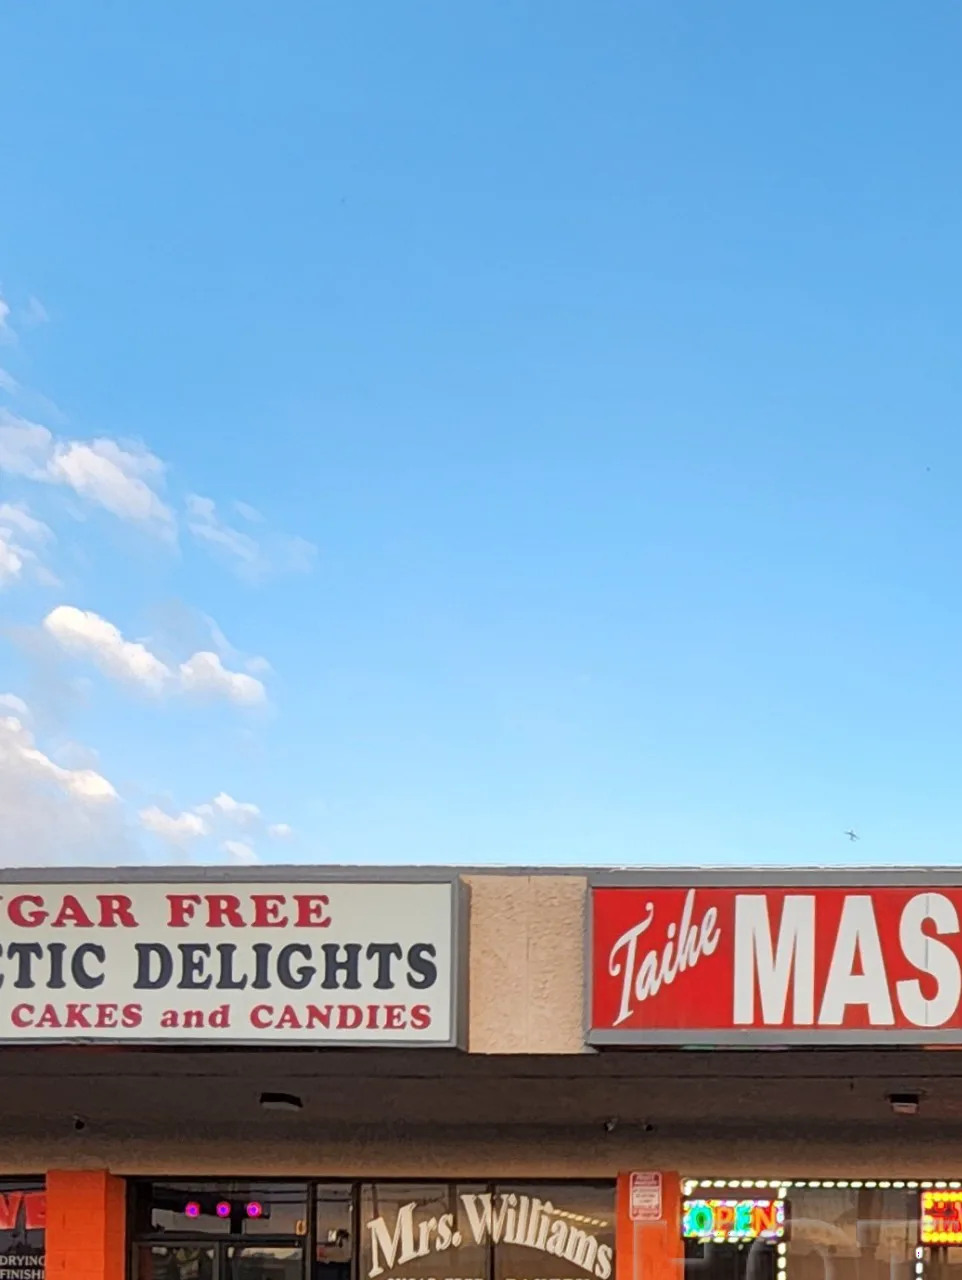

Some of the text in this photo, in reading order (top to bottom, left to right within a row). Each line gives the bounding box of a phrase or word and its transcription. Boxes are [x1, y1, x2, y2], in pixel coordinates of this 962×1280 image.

[0, 894, 332, 928] GAR FREE
[0, 942, 437, 990] TIC DELIGHTS
[608, 889, 720, 1026] Taihe
[11, 1003, 432, 1029] CAKES and CANDIES
[366, 1201, 463, 1279] Mrs.
[460, 1192, 613, 1280] Williams
[688, 1203, 777, 1234] OPEN
